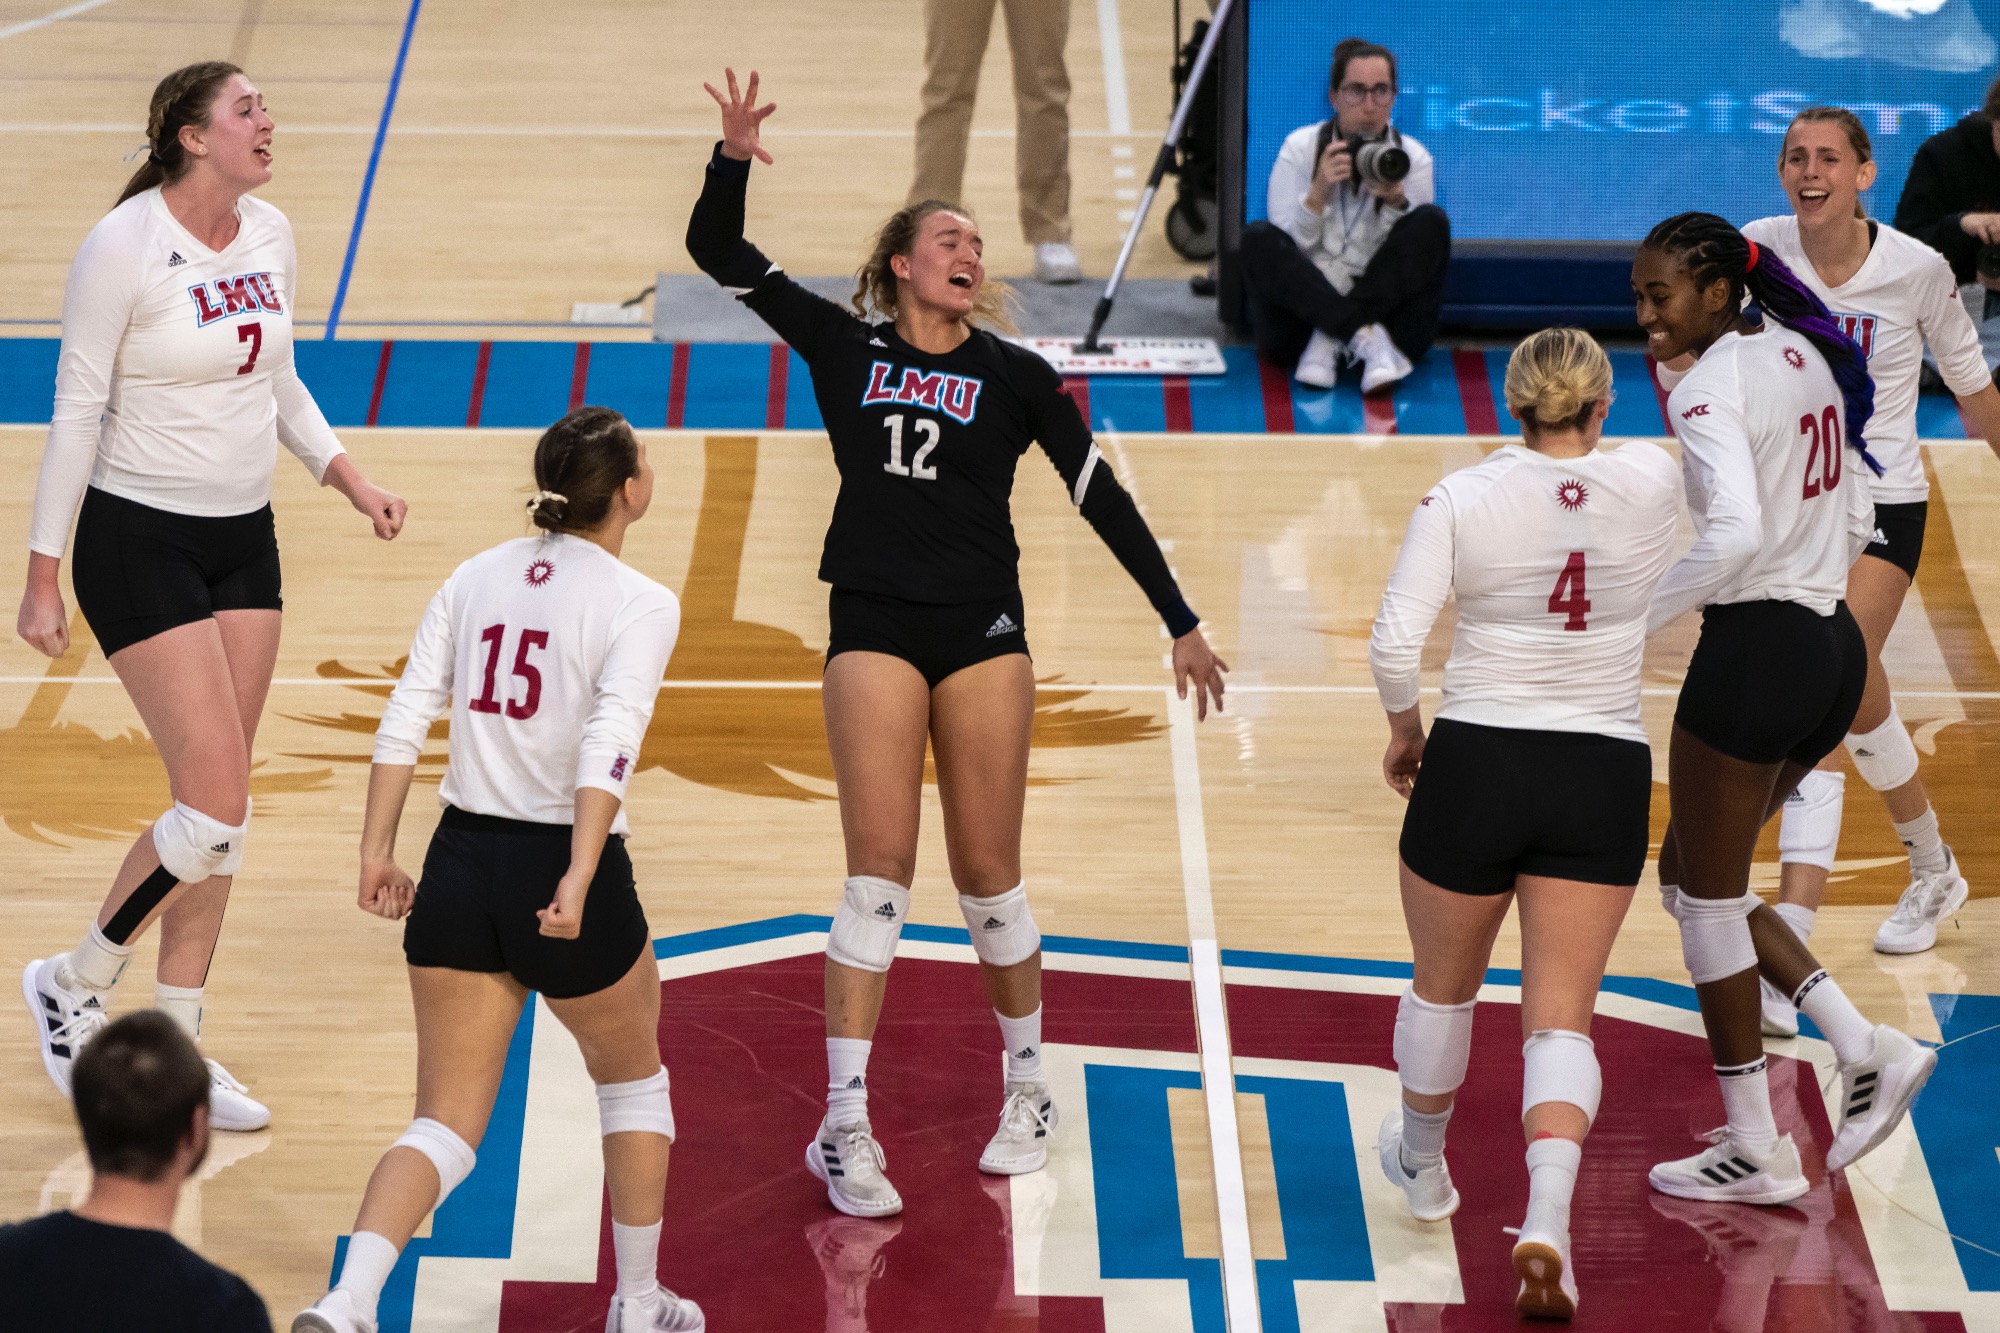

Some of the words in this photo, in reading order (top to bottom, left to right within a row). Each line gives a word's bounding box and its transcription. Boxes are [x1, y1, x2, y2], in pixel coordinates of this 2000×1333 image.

[188, 271, 283, 328] LMU
[237, 322, 262, 375] 7
[860, 359, 983, 426] LMU
[883, 413, 941, 481] 12
[1800, 404, 1842, 501] 20
[1548, 551, 1592, 632] 4
[468, 623, 550, 721] 15
